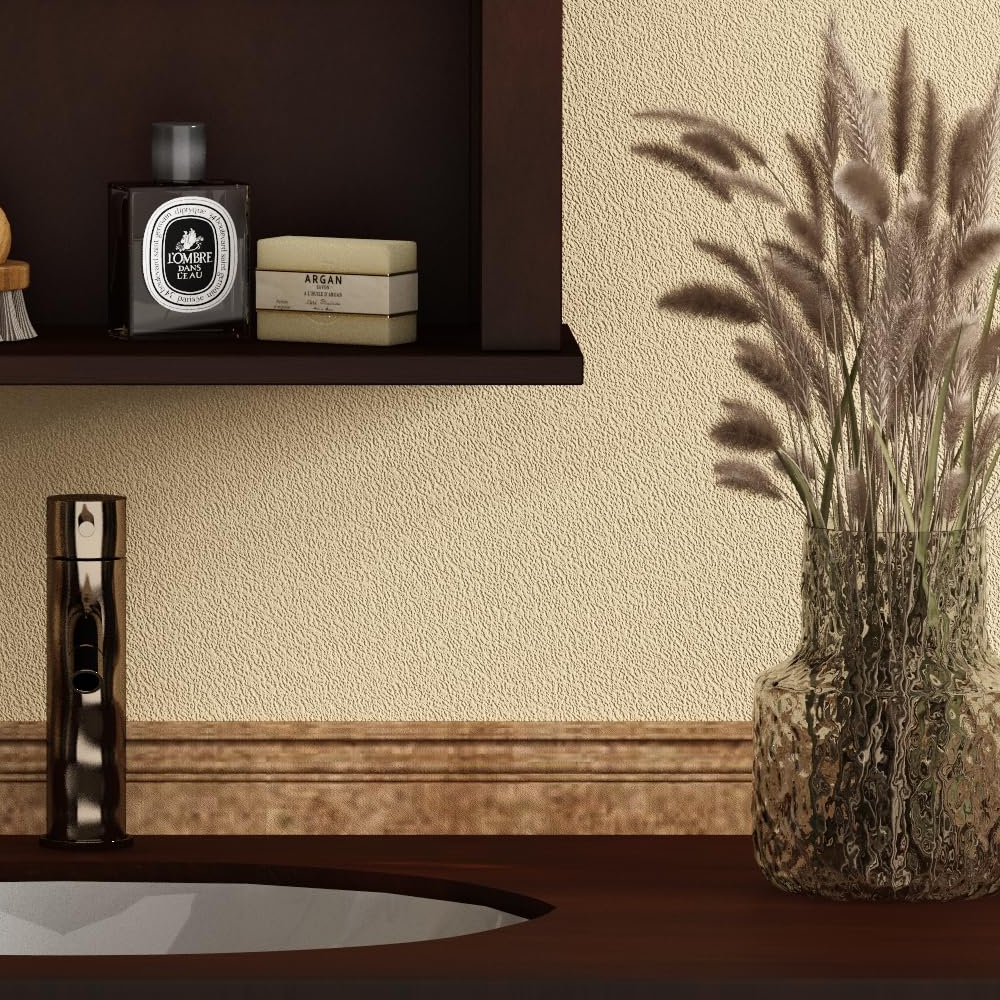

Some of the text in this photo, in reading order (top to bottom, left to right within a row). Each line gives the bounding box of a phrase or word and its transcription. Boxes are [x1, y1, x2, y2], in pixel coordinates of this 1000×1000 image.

[167, 251, 213, 264] L'OMBRE
[178, 264, 202, 272] DANS
[177, 271, 203, 280] L'EAU
[304, 274, 342, 285] ARGAN
